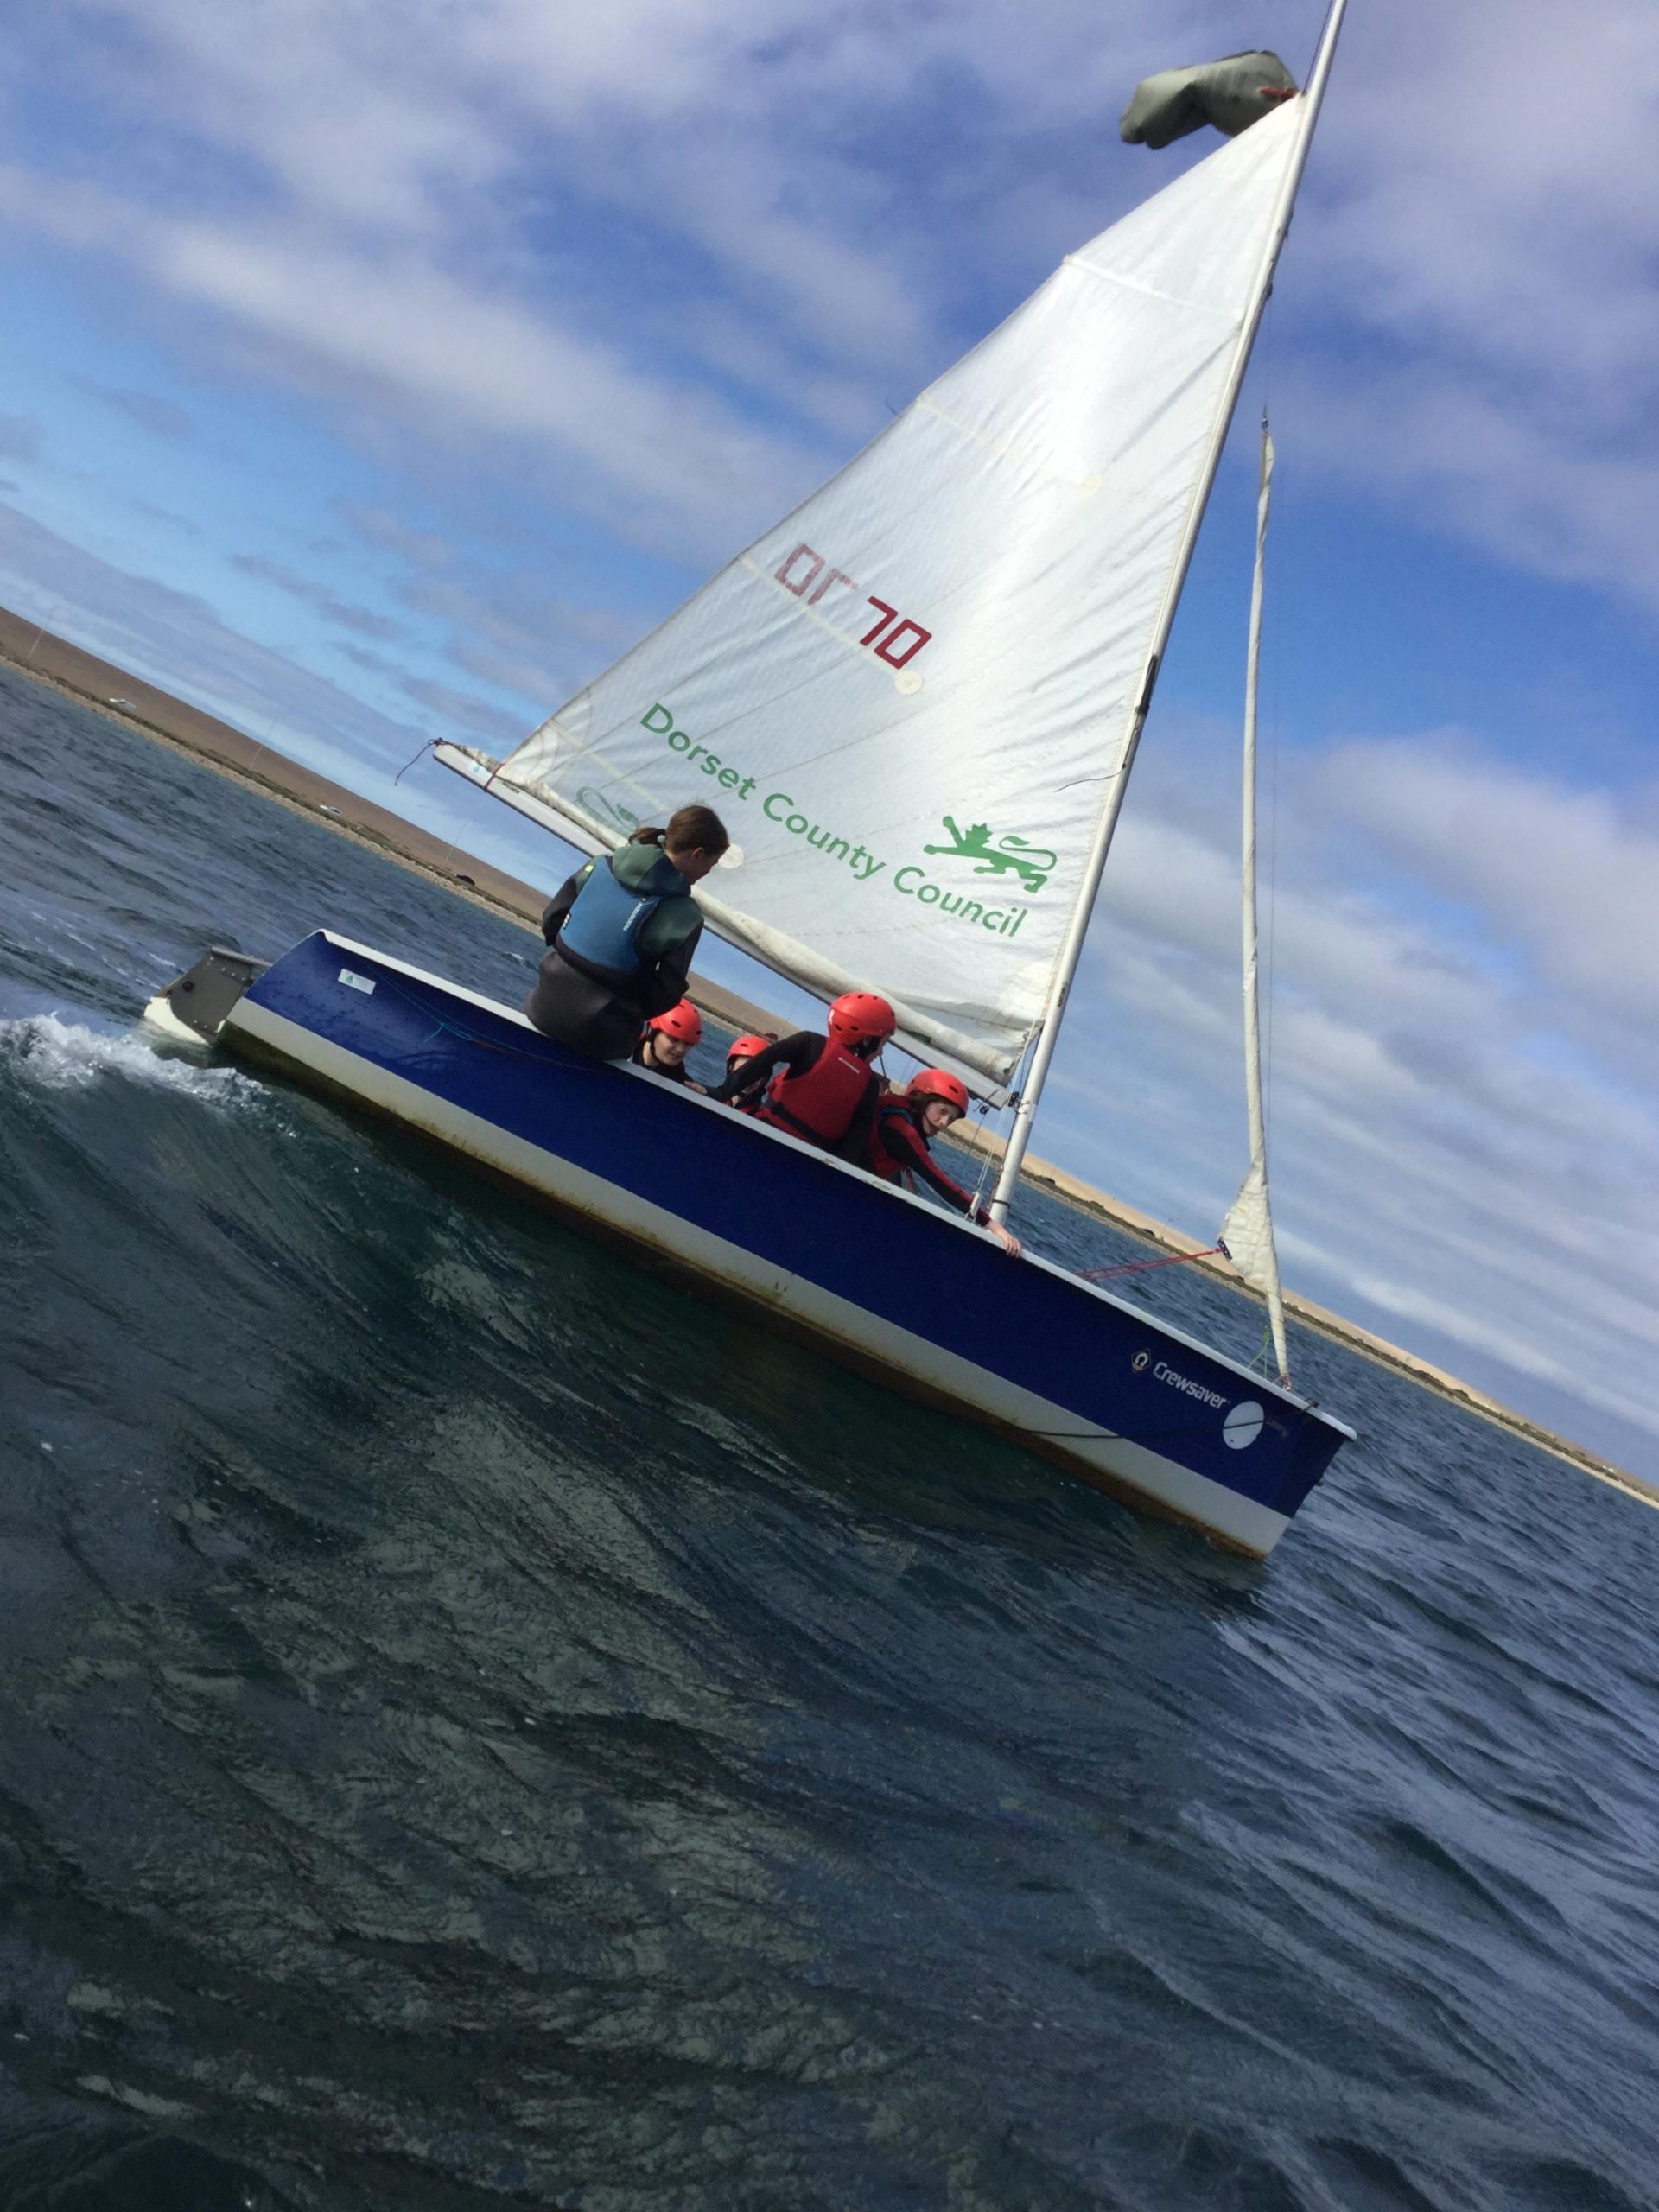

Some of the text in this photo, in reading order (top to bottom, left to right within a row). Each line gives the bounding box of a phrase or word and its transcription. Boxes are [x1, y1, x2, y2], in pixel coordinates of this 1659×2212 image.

[859, 595, 932, 670] 70
[639, 702, 1028, 938] Dorset County Council
[1152, 1361, 1228, 1409] Crewsaver
